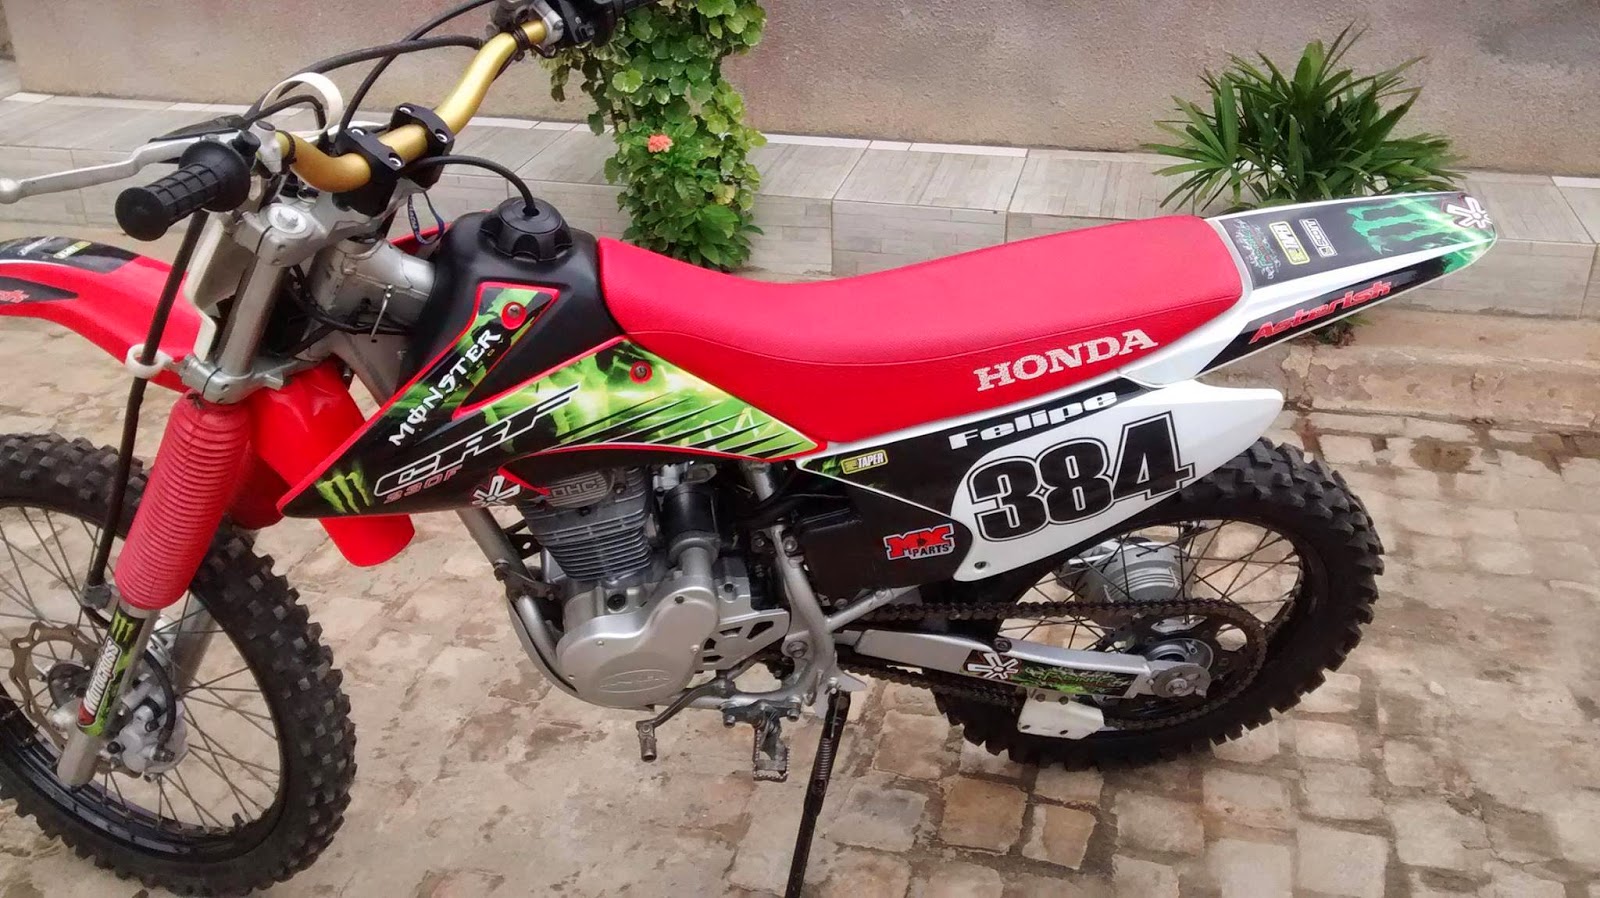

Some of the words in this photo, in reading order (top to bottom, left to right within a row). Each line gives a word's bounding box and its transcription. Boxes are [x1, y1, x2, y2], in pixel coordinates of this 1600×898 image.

[388, 330, 501, 446] MONSTER
[973, 329, 1158, 392] HONDA
[948, 391, 1117, 450] Felipe
[857, 452, 884, 469] TAPER
[966, 411, 1195, 542] 384
[885, 525, 952, 559] MX
[911, 543, 950, 557] PARTS
